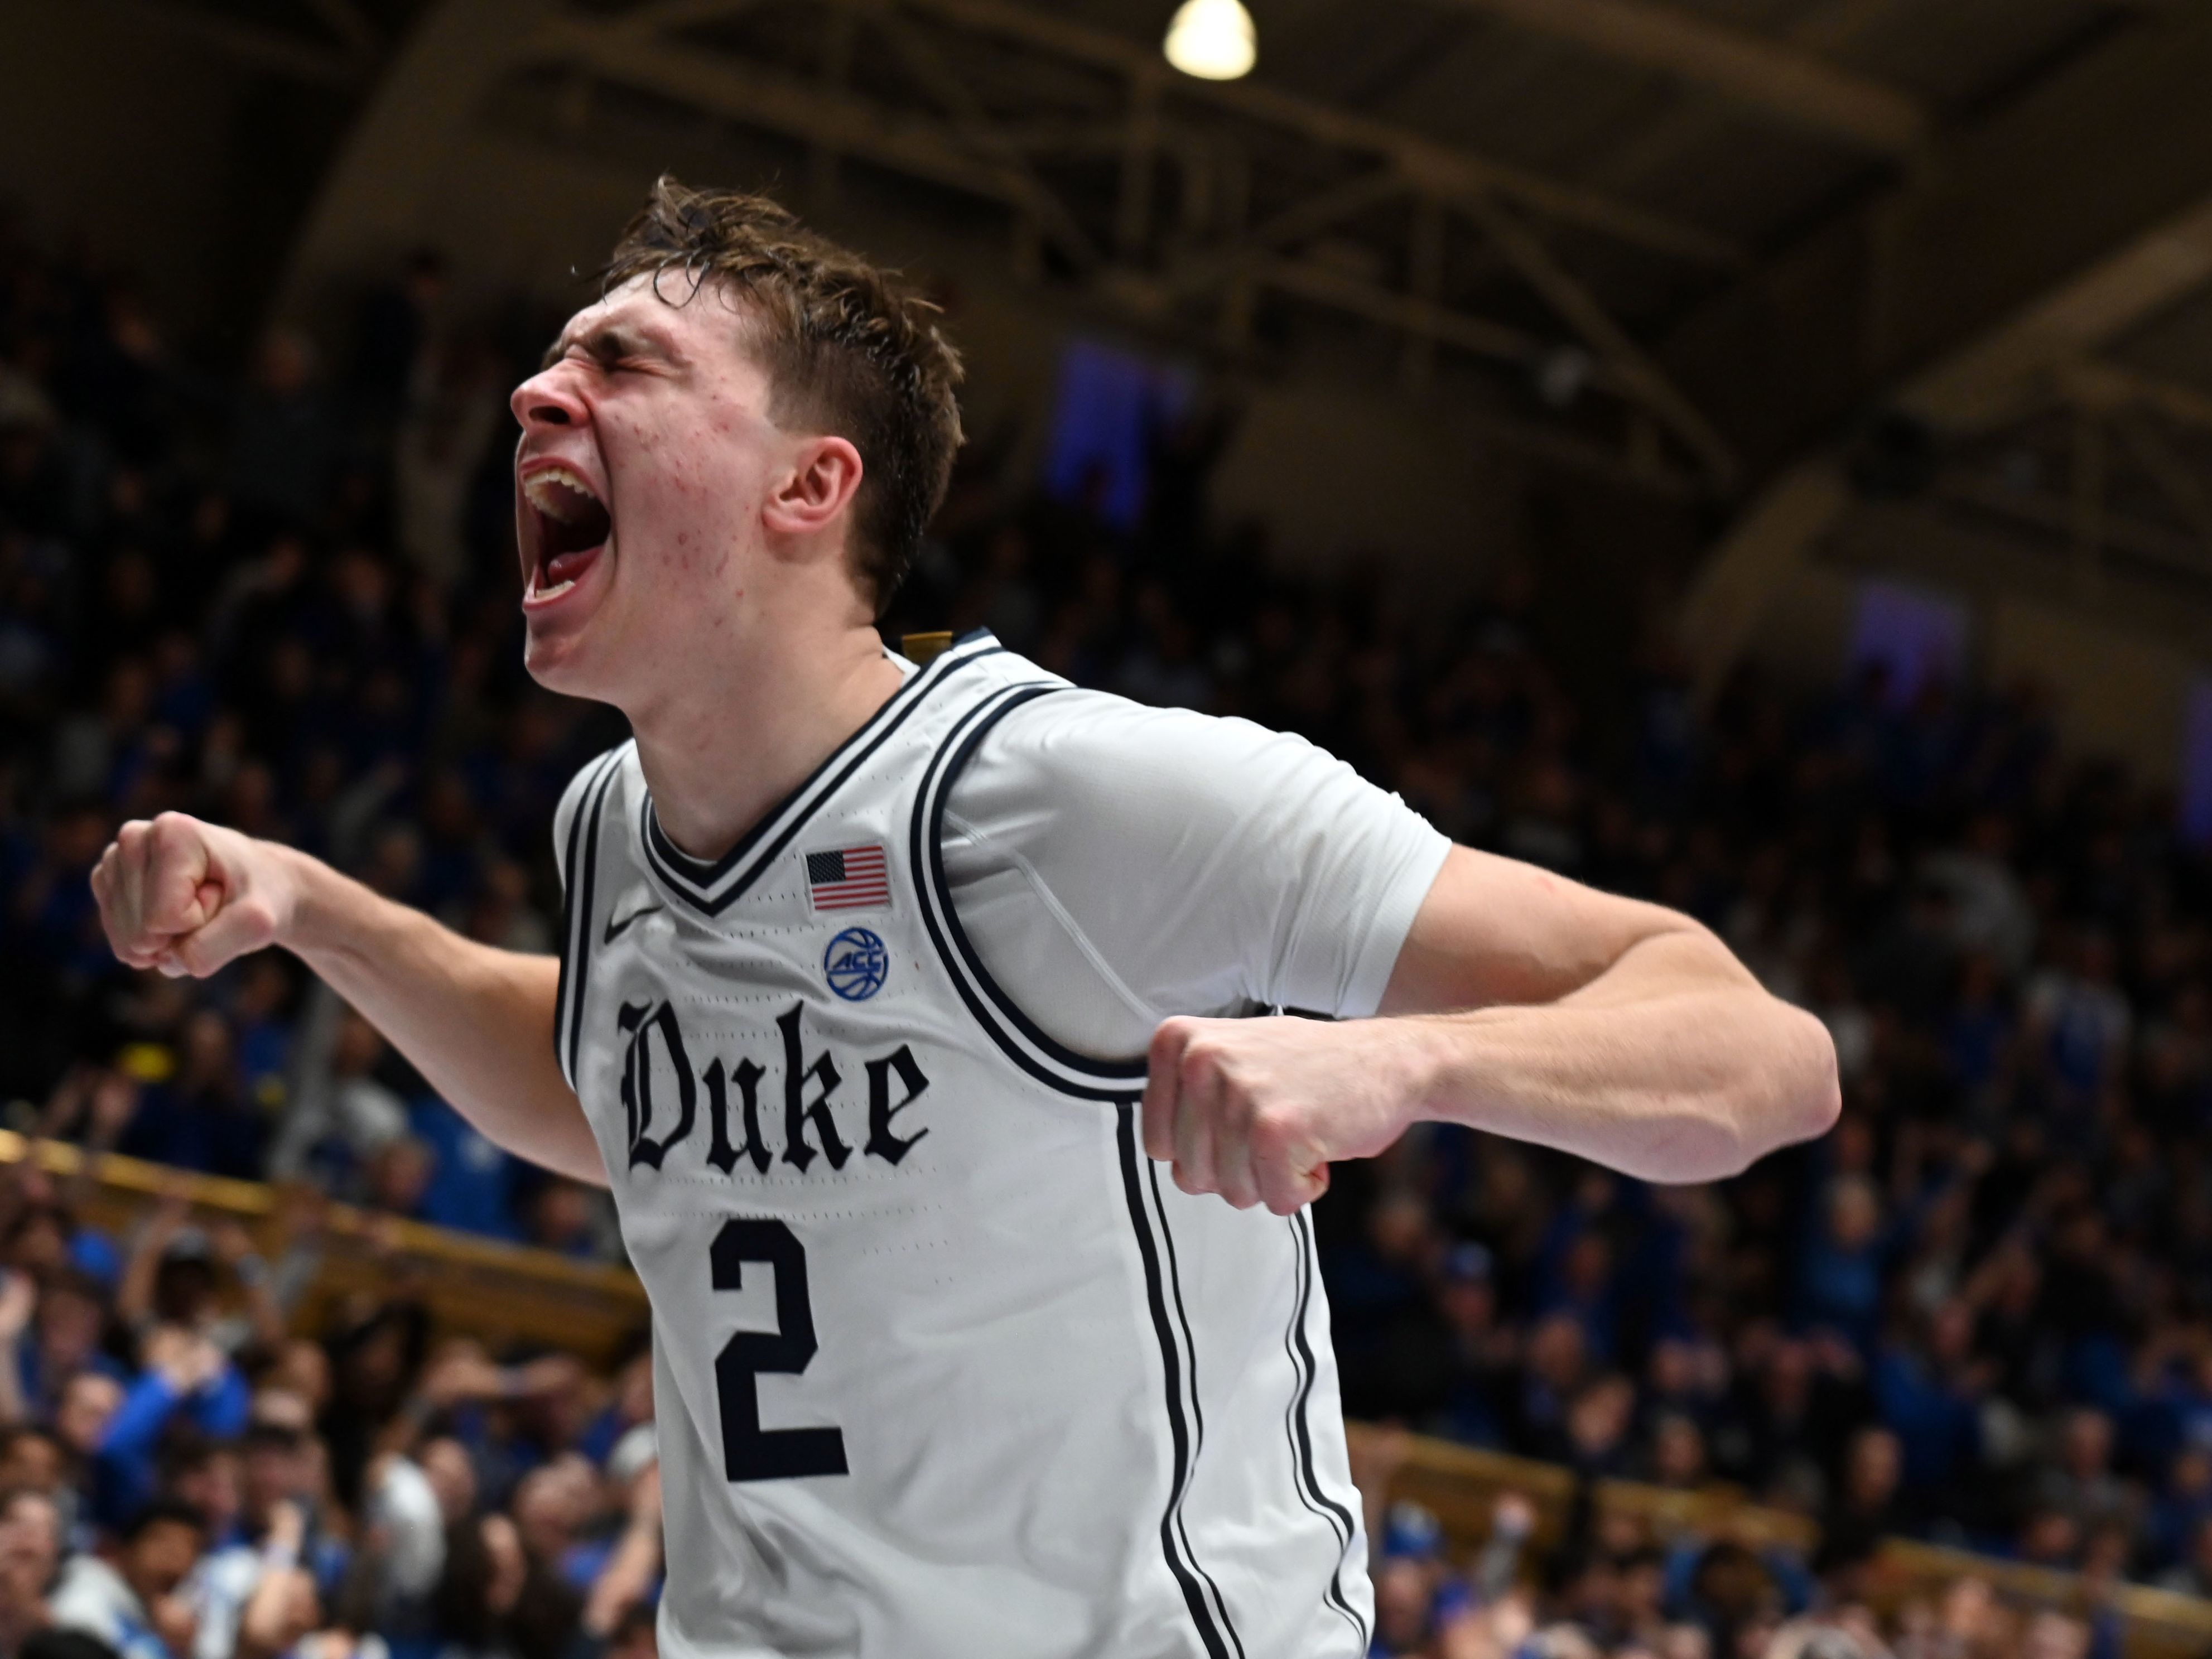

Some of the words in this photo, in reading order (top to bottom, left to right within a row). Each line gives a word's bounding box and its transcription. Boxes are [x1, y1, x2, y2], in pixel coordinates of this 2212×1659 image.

[832, 951, 884, 972] ACC
[618, 999, 929, 1175] Duke
[710, 1218, 849, 1482] 2
